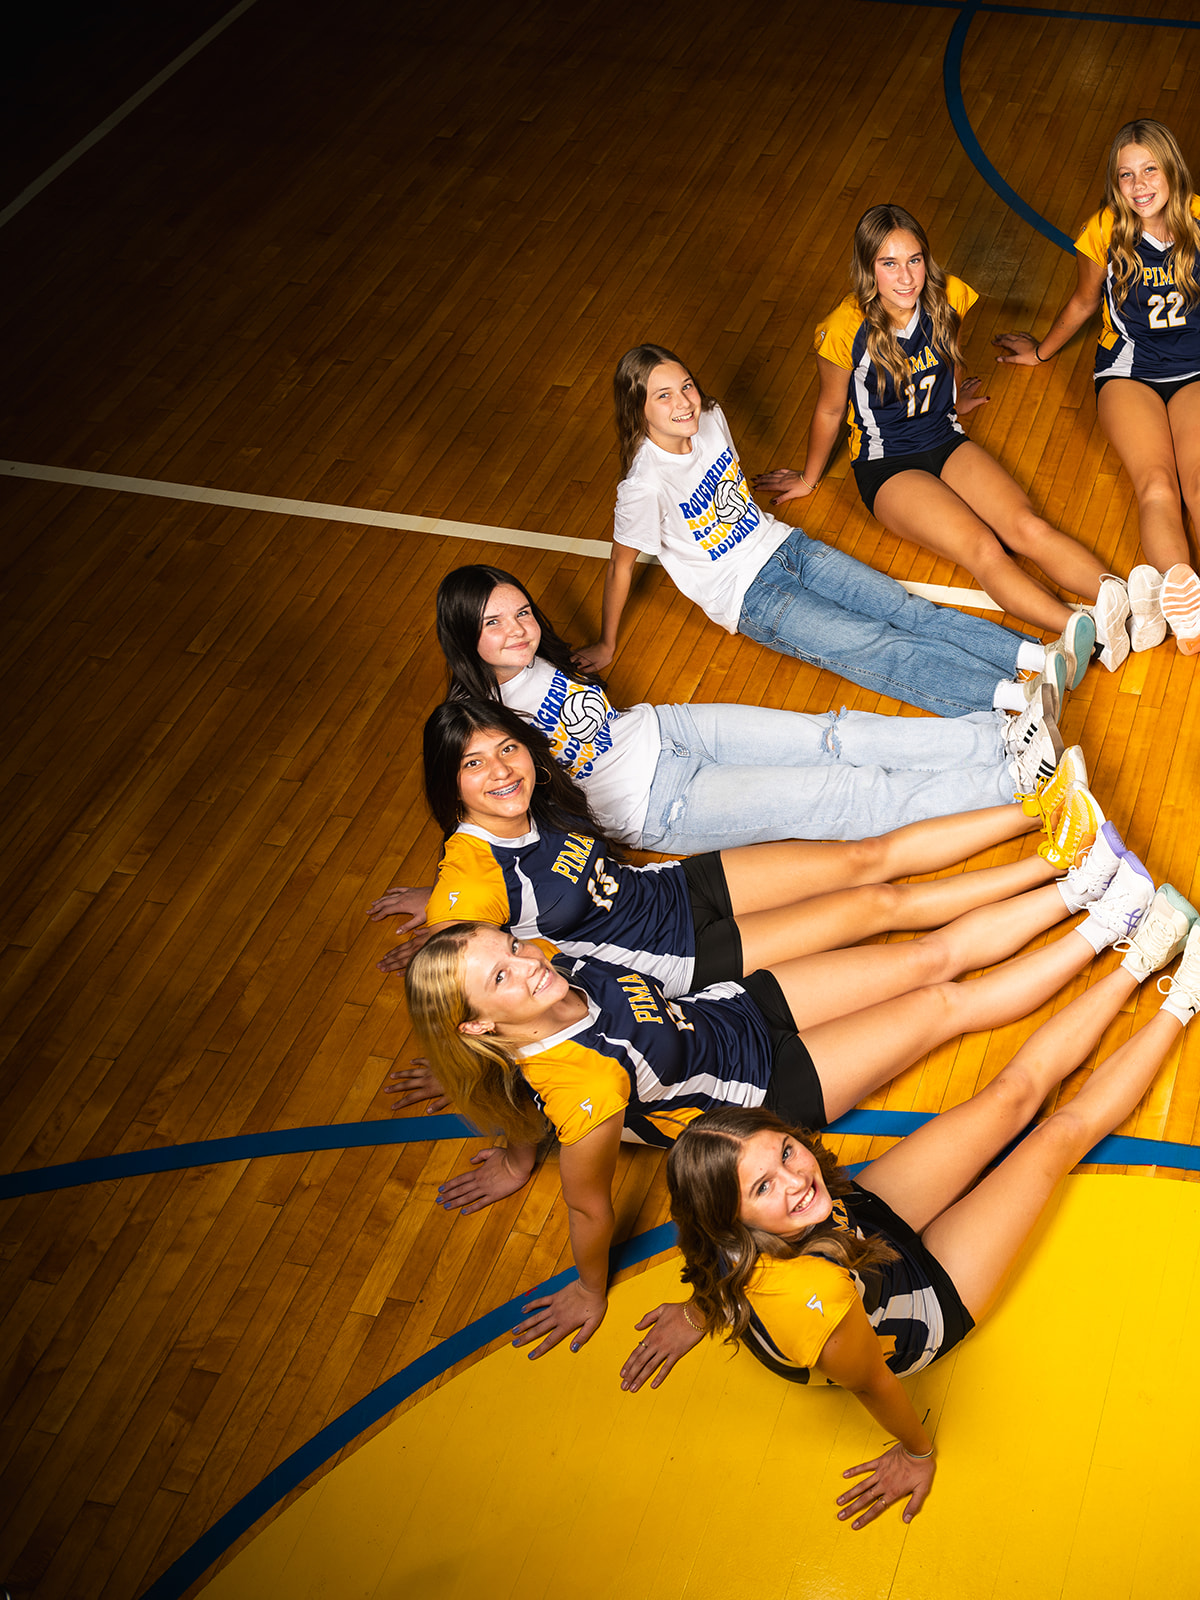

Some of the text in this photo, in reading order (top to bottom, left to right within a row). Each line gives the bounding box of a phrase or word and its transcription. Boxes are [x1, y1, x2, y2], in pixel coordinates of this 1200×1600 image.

[1147, 291, 1187, 330] 22
[904, 374, 937, 418] 17
[549, 832, 595, 885] PIMA
[616, 973, 664, 1025] PIMA
